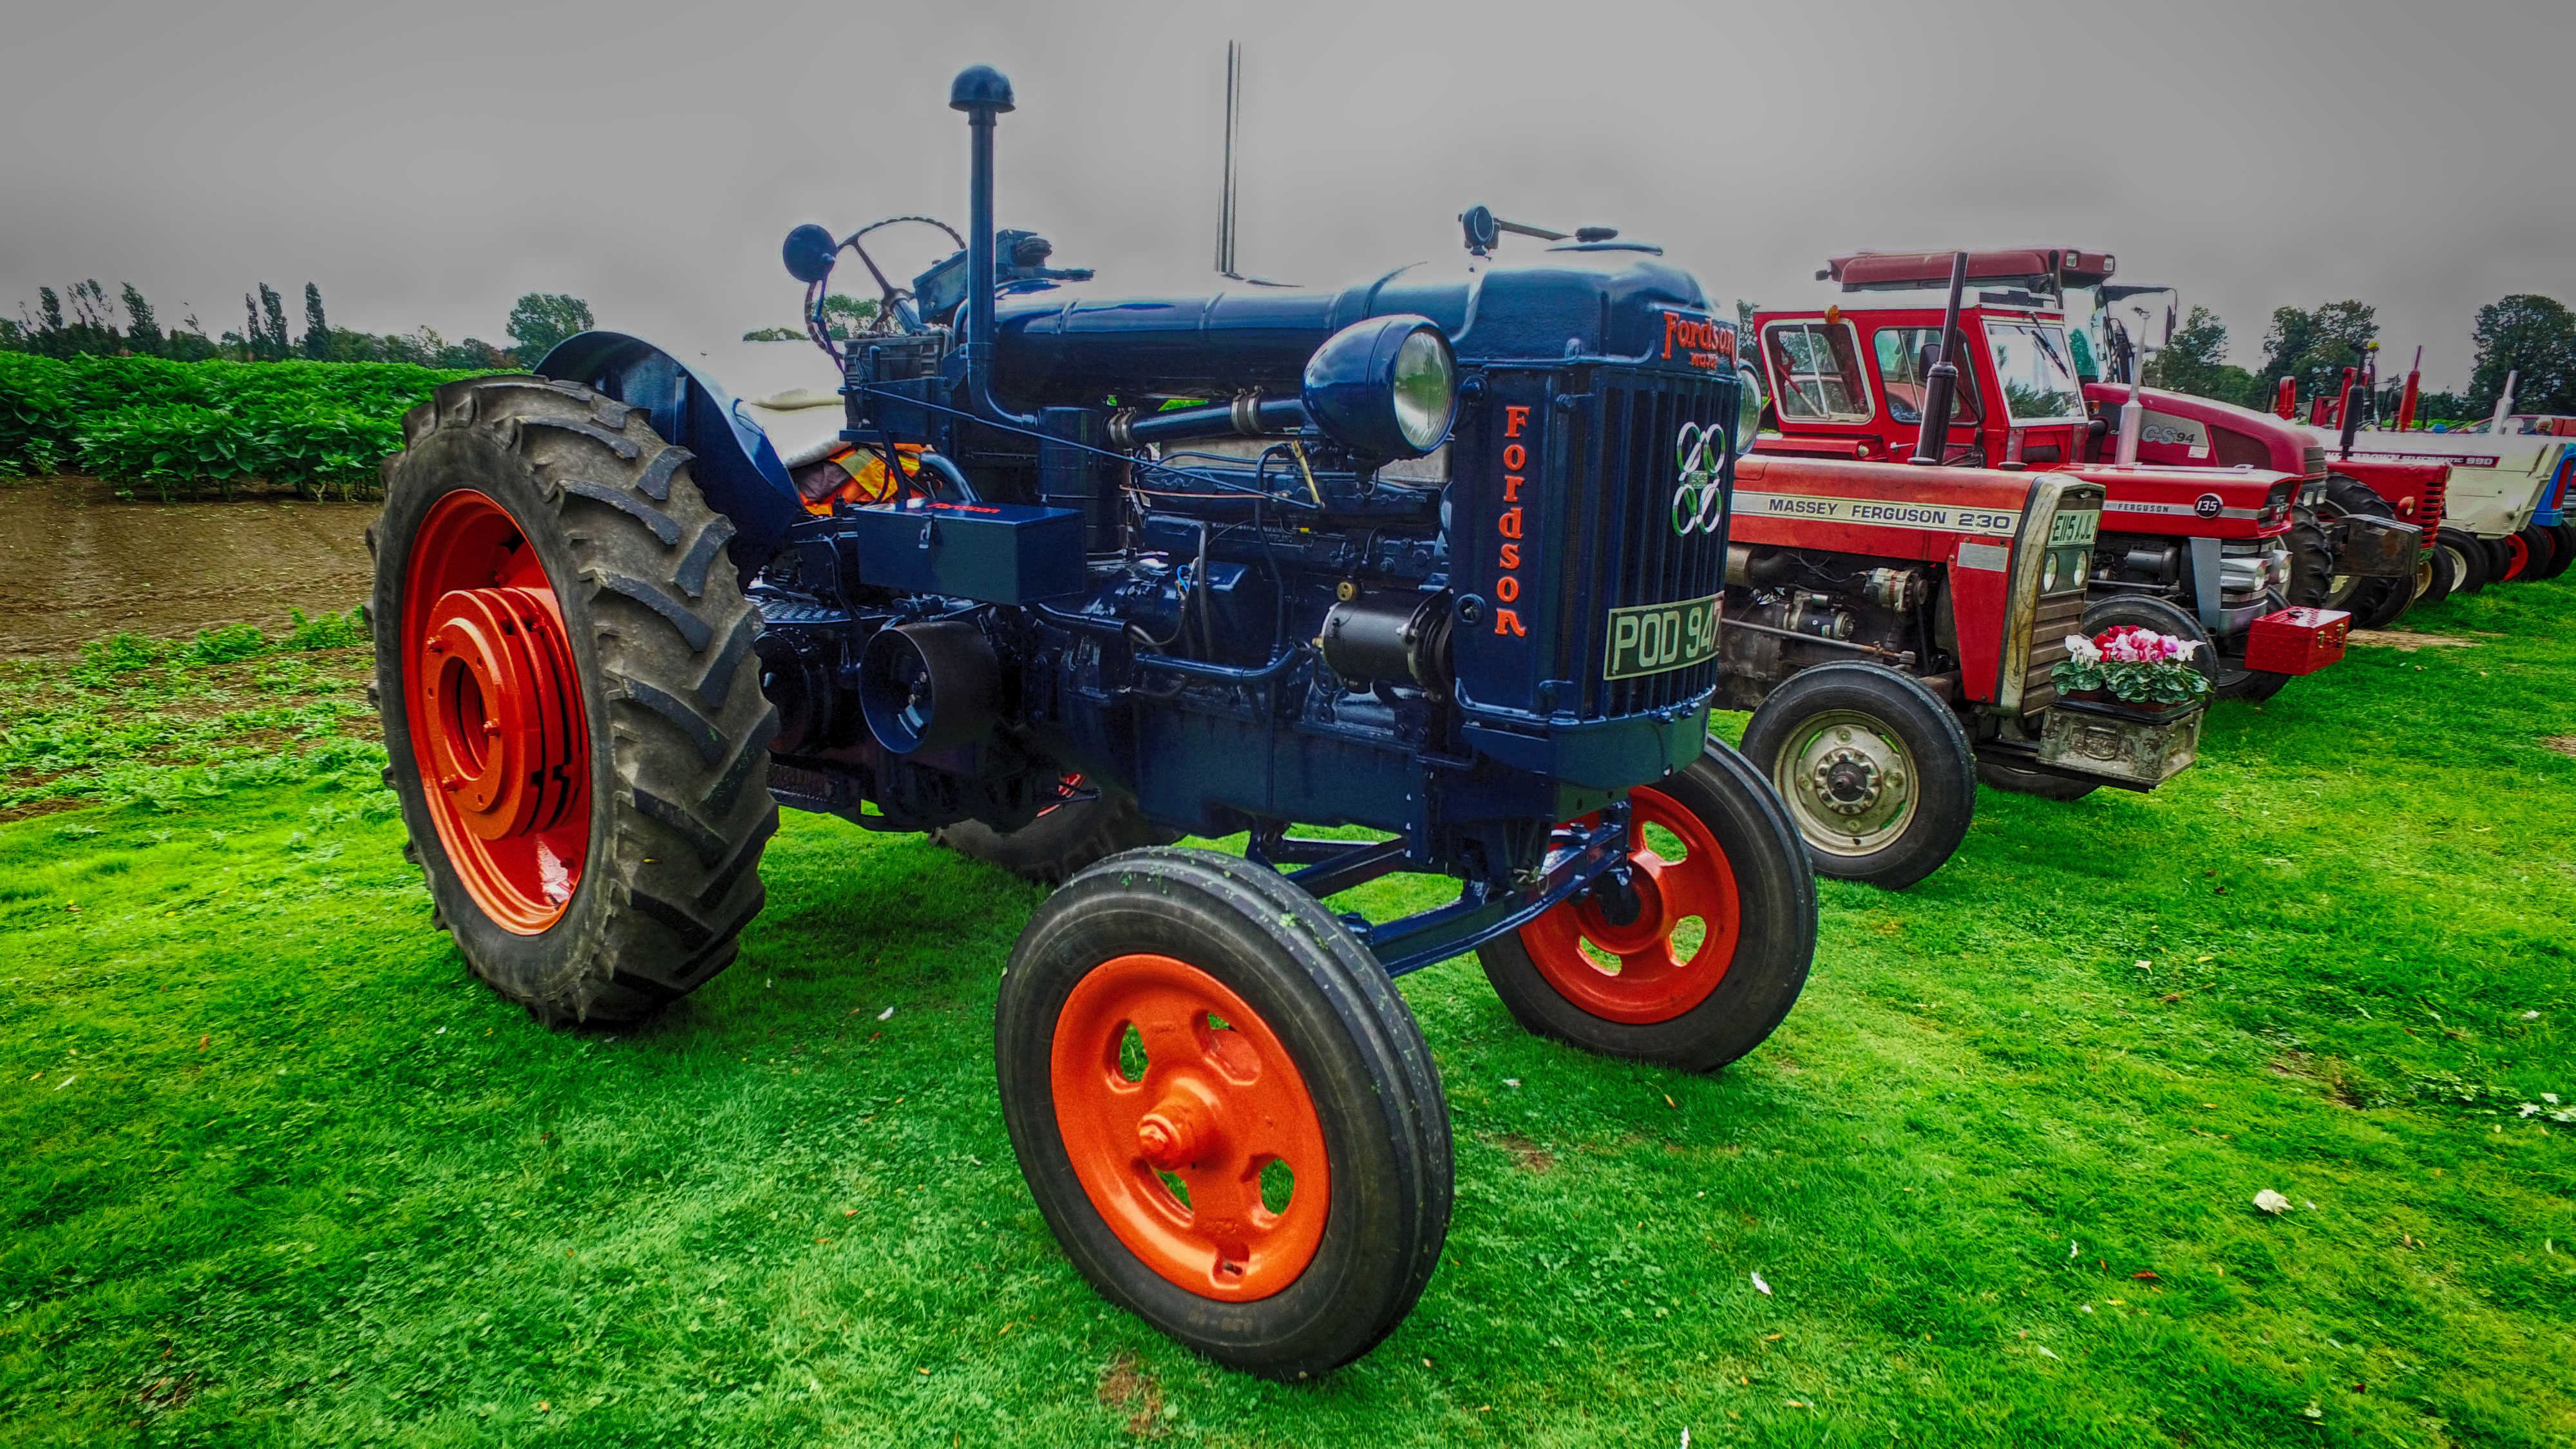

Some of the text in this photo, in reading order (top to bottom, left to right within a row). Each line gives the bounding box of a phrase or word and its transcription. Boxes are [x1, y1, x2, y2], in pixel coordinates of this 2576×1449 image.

[1661, 310, 1737, 369] Fordson
[1495, 406, 1530, 638] Fordson
[1768, 499, 2010, 529] MASSEY FERGUSON 230
[2117, 503, 2169, 513] FERGUSON
[2196, 500, 2218, 511] 135
[1613, 600, 1722, 672] POD 947
